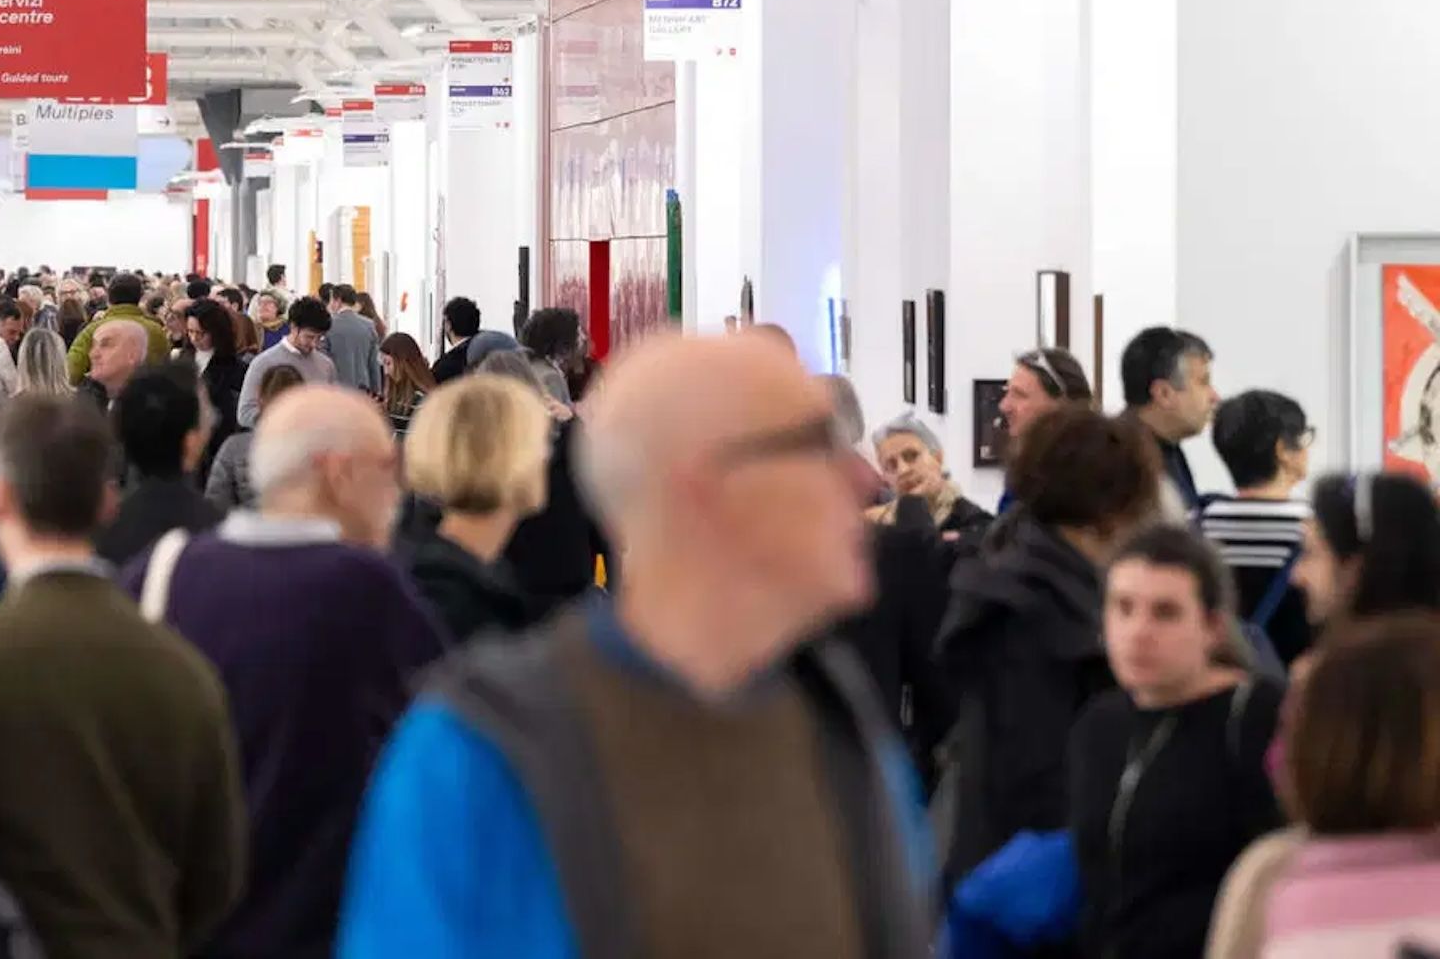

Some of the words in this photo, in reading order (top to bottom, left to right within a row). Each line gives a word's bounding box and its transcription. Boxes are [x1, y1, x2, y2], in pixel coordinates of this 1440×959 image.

[1, 73, 39, 83] Guided
[40, 74, 69, 83] tours
[35, 104, 114, 123] Multiples
